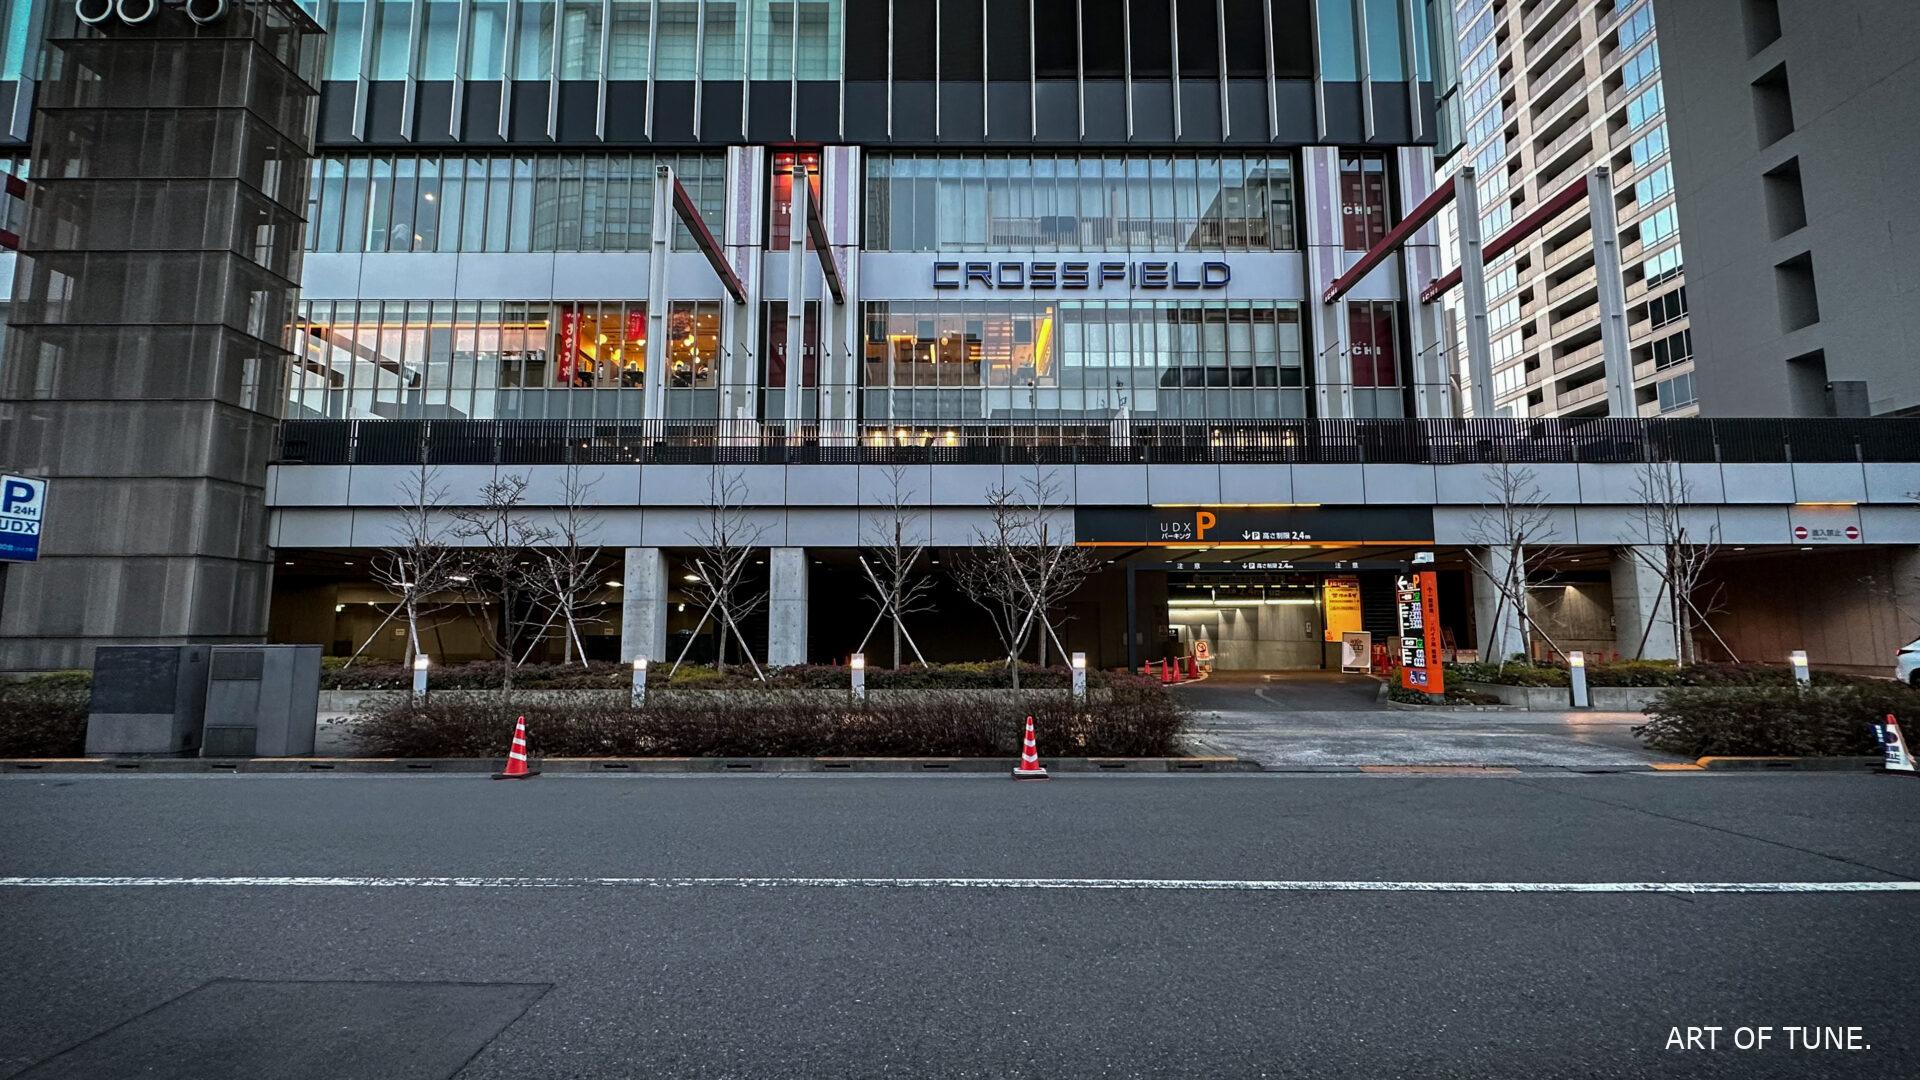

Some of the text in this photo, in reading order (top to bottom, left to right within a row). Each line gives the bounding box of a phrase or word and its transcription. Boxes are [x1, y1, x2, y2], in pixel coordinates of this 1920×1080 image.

[933, 261, 1231, 289] CROSSFIELD
[2, 480, 35, 513] P
[13, 505, 37, 516] 24H
[1160, 522, 1191, 532] UDX
[1196, 511, 1216, 540] P
[1413, 574, 1420, 589] P
